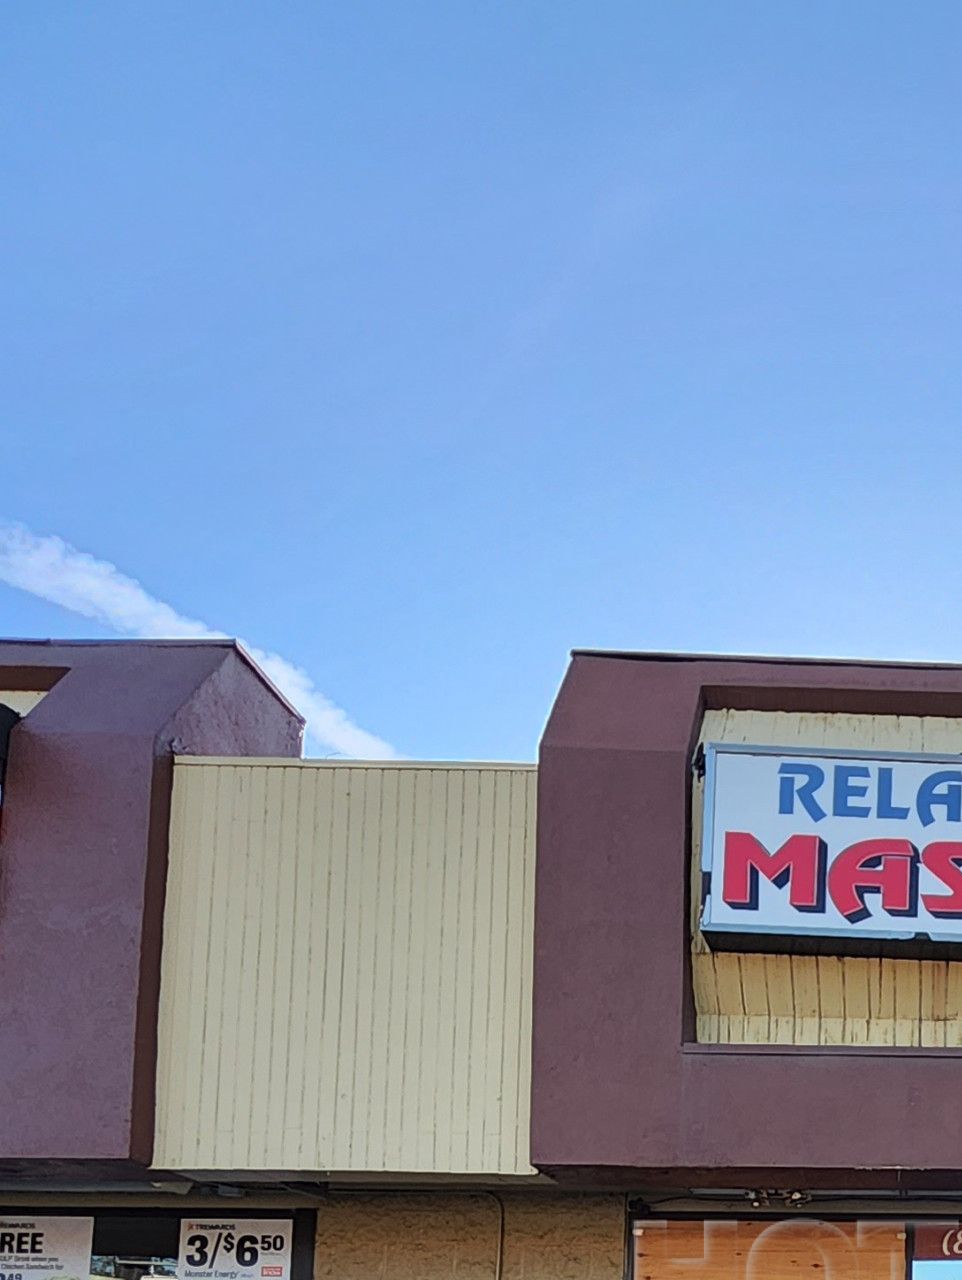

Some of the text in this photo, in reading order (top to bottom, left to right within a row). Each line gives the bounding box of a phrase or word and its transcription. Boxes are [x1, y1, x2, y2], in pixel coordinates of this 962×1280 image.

[0, 1232, 44, 1254] REE
[184, 1269, 213, 1278] Monster
[214, 1269, 238, 1279] Energy
